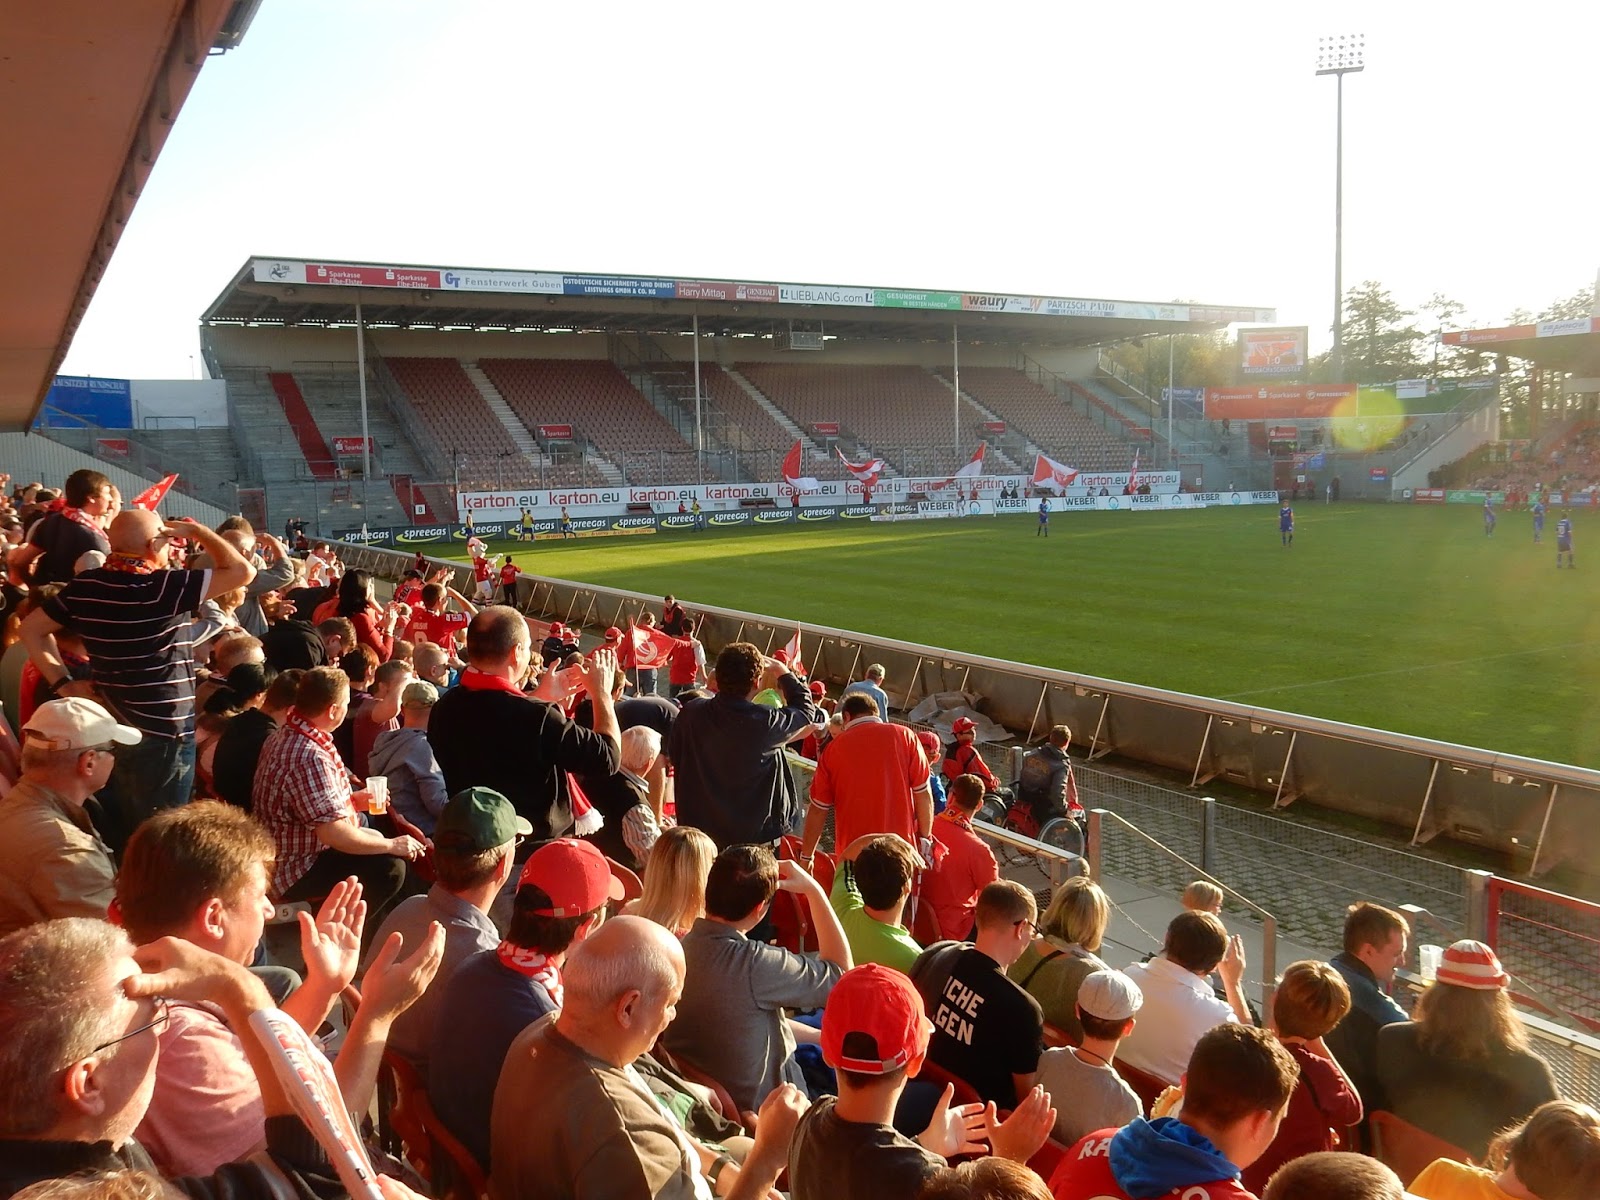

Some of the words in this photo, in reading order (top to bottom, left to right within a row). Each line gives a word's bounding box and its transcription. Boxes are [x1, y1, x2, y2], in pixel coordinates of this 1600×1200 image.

[329, 270, 361, 280] Sparkasse
[397, 274, 428, 283] Sparkasse
[445, 272, 460, 288] GT
[465, 277, 528, 288] Fensterwerk
[532, 280, 561, 289] Guben
[564, 278, 602, 286] OSTDEUTSCHE
[584, 286, 614, 294] LEISTUNGS
[679, 287, 700, 298] Harry
[701, 288, 726, 299] Mittag
[747, 288, 776, 296] GENERALI
[791, 290, 863, 303] LIEBLANG.com
[969, 295, 1008, 310] waury
[1047, 300, 1086, 310] PARTZSCH
[53, 379, 88, 388] LAUSITZER
[89, 380, 125, 389] RUNDSCHAU
[1269, 391, 1300, 400] Sparkasse
[969, 477, 1020, 490] karton.eu
[1081, 475, 1127, 486] karton.eu
[1135, 473, 1177, 484] arton.eu
[705, 486, 769, 499] karton.eu
[777, 483, 837, 496] ka.eu
[845, 481, 901, 494] kaon.eu
[549, 491, 620, 505] karton.eu
[629, 488, 696, 502] karton.eu
[1131, 495, 1160, 503] WEBER
[1192, 493, 1220, 501] WEBER
[1251, 491, 1277, 499] WEBER
[463, 494, 538, 509] karton.eu
[919, 501, 955, 511] WEBER
[995, 500, 1027, 508] WEBER
[1065, 498, 1095, 506] WEBER
[667, 515, 703, 525] spreeGs
[461, 524, 502, 535] sreeGas
[515, 521, 555, 532] seeGas
[282, 908, 288, 917] 5
[932, 1002, 974, 1046] GEN
[1077, 1137, 1111, 1160] RA
